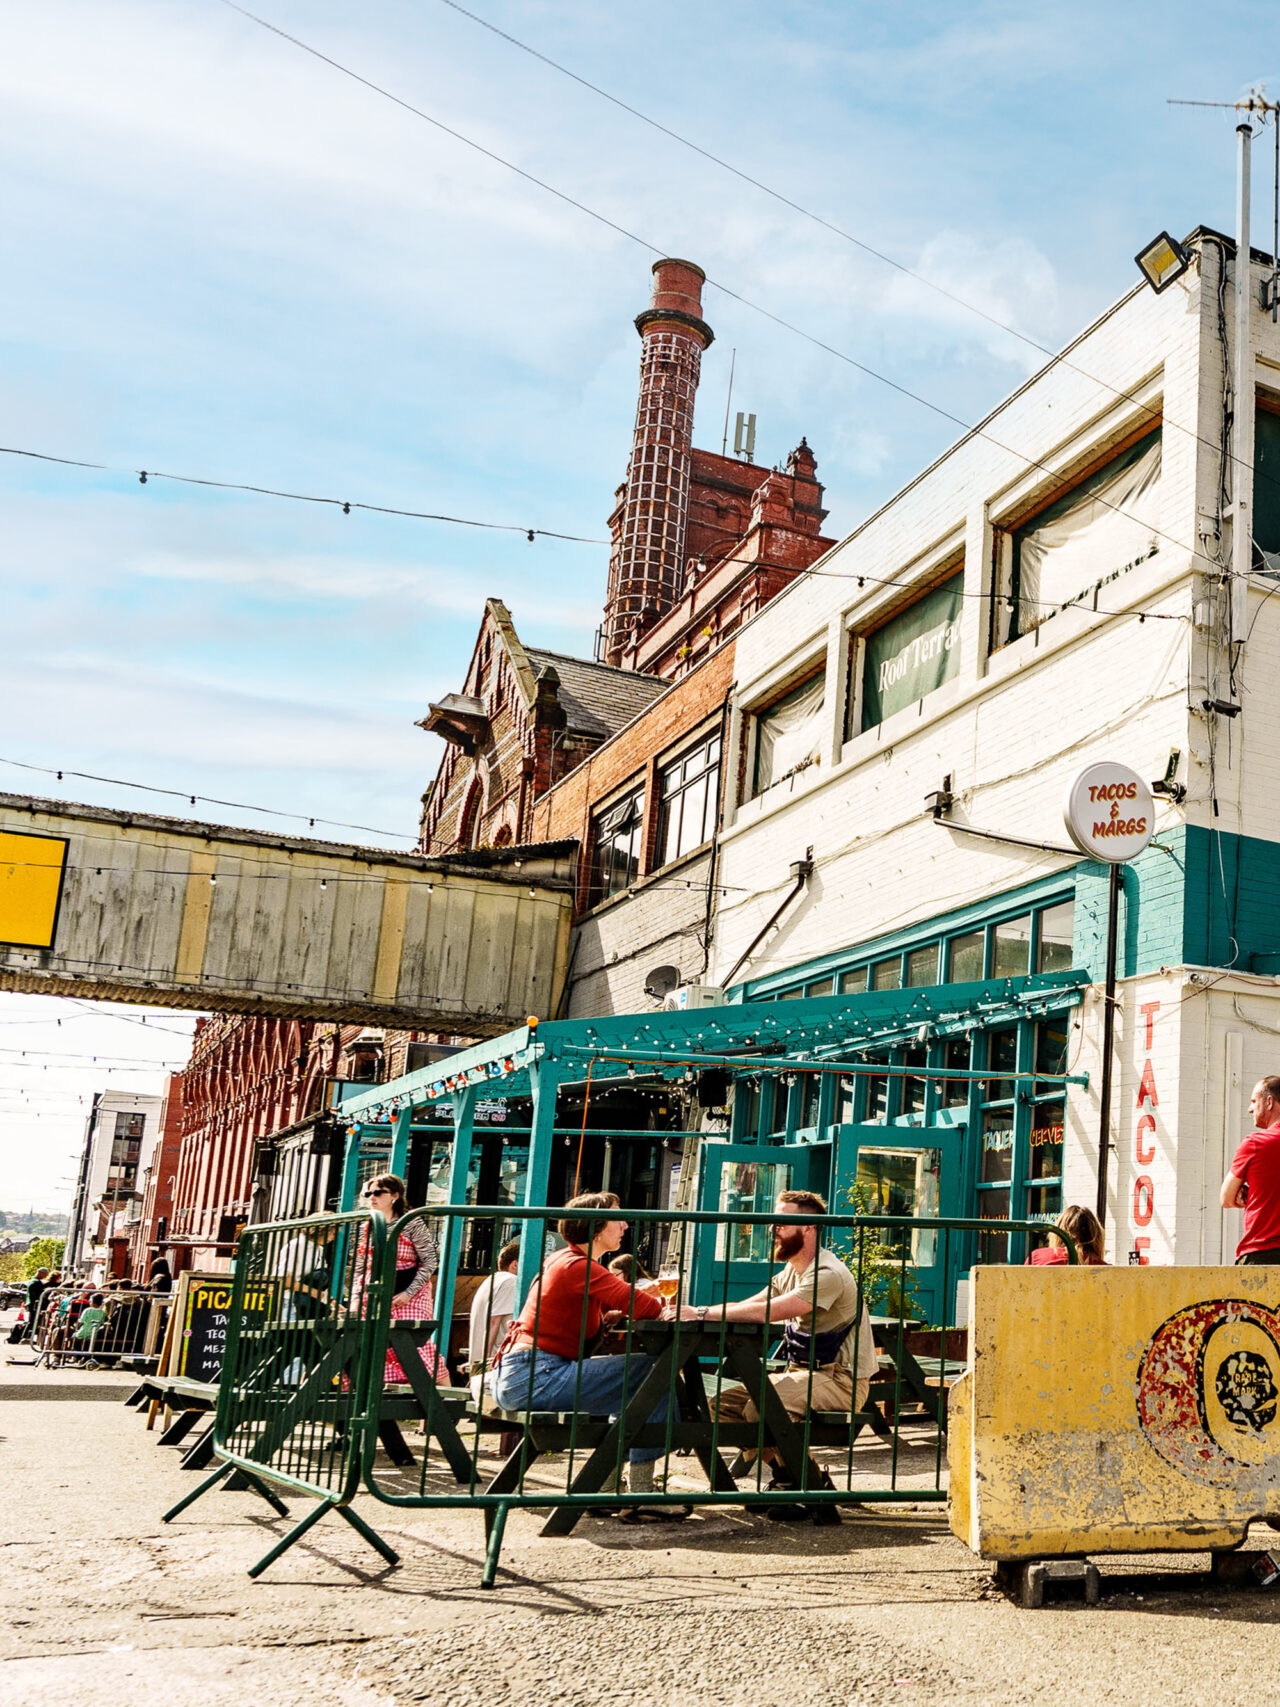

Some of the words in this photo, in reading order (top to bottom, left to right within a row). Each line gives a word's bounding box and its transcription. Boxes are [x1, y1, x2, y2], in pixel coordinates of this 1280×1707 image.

[878, 644, 910, 693] Roof
[1087, 781, 1138, 803] TACOS
[1109, 800, 1120, 820] &
[1091, 816, 1147, 839] MARGS
[196, 1290, 266, 1311] PICTE
[211, 1313, 248, 1326] TAS
